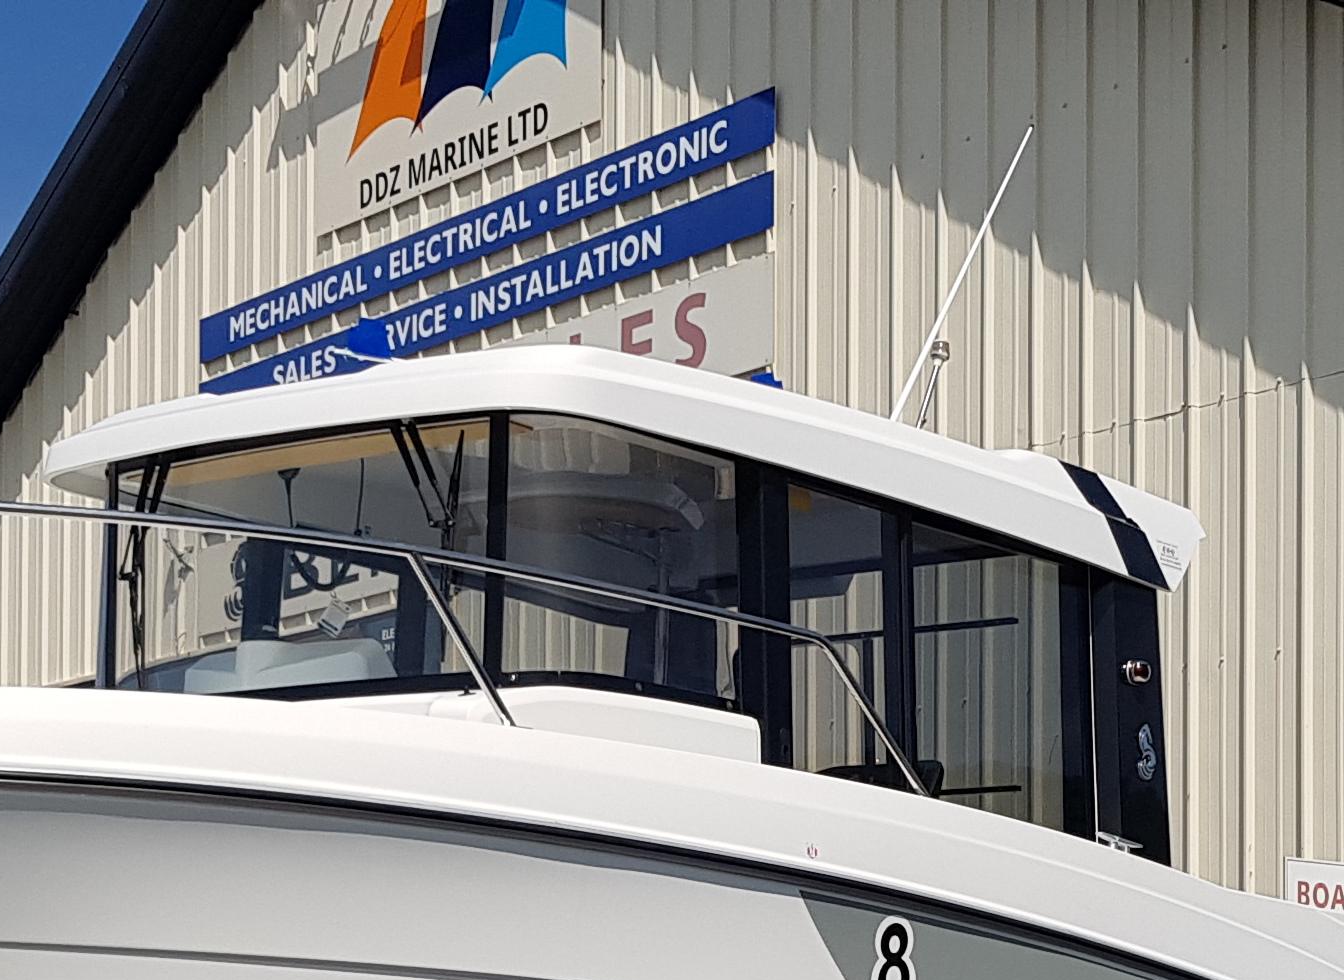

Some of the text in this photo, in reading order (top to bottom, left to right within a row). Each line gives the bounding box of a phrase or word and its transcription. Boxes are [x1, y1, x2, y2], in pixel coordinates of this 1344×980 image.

[359, 102, 549, 210] DDZ MARINE LTD
[228, 120, 729, 343] MECHANICAL ELECTRICAL ELECTRONIC
[470, 224, 662, 322] INSTALLATION
